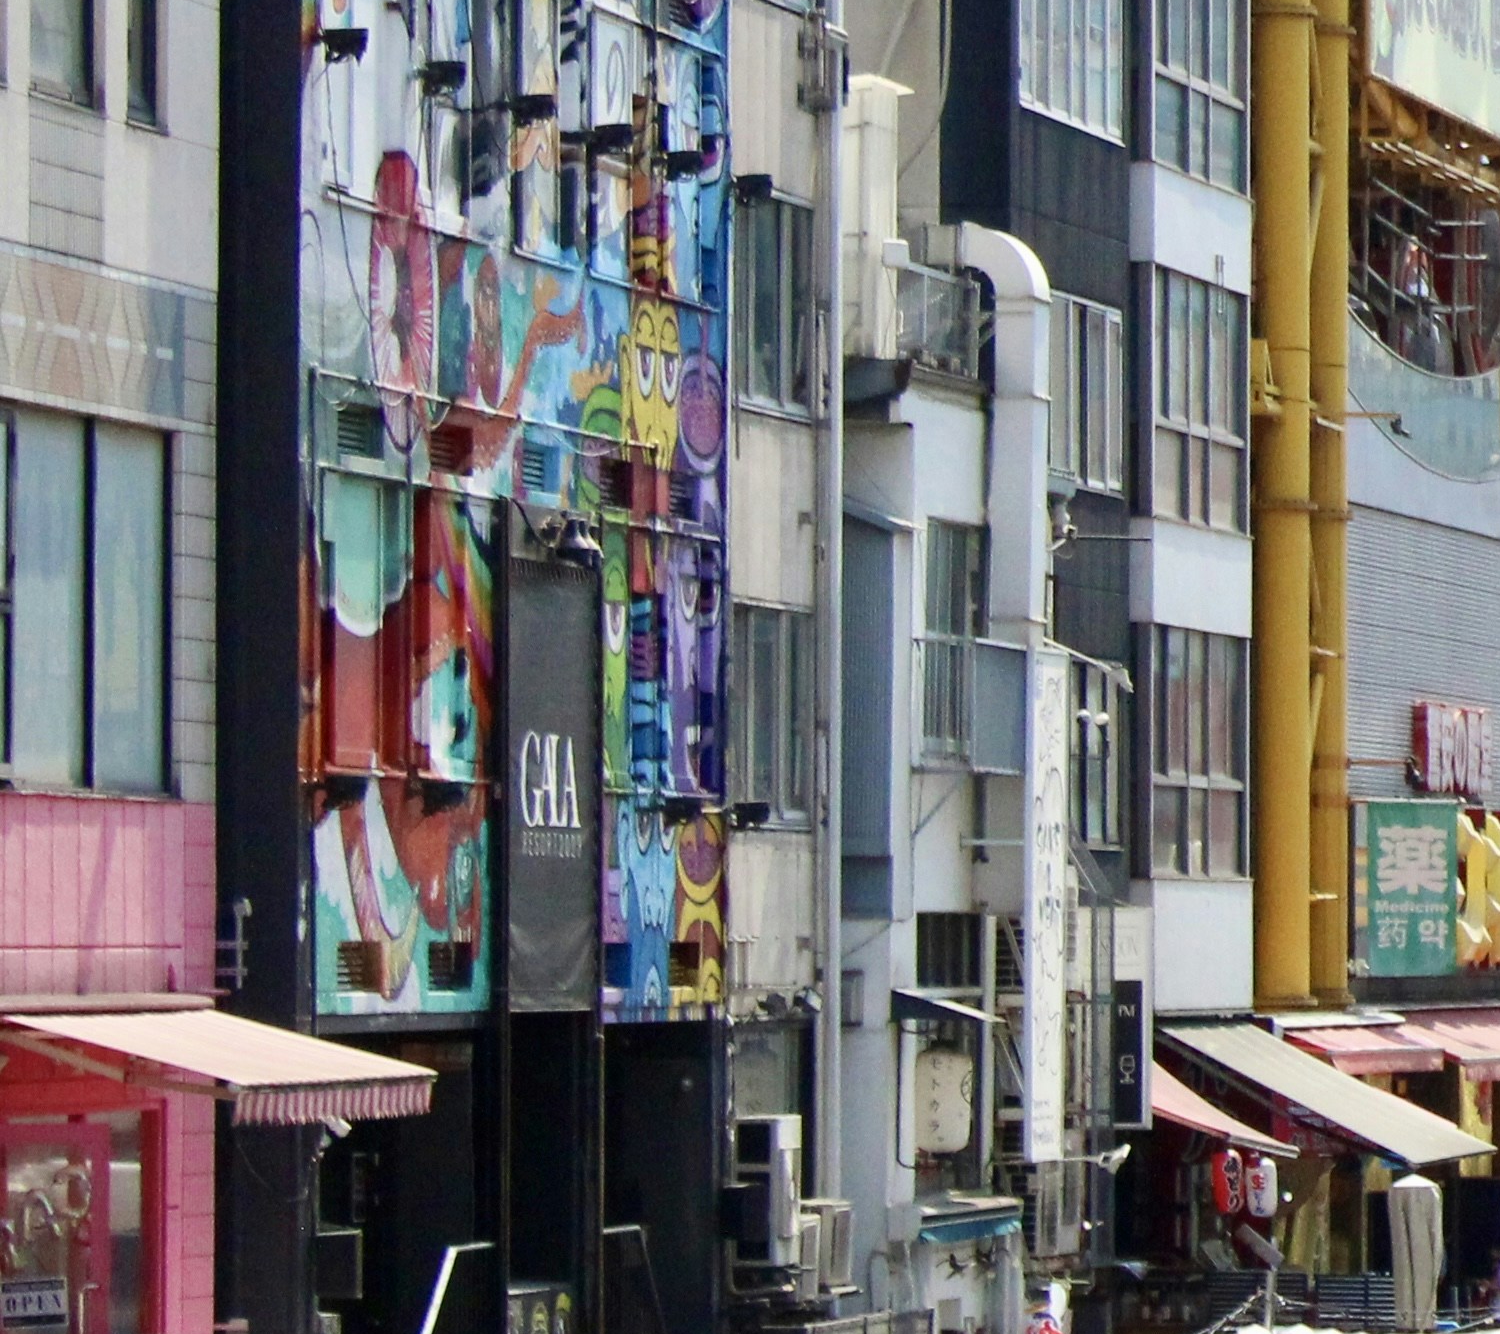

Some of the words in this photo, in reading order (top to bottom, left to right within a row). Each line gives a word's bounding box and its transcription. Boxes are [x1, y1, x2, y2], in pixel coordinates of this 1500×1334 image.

[520, 730, 582, 829] GALA
[1377, 824, 1449, 895] 薬
[1374, 899, 1449, 914] Medicine
